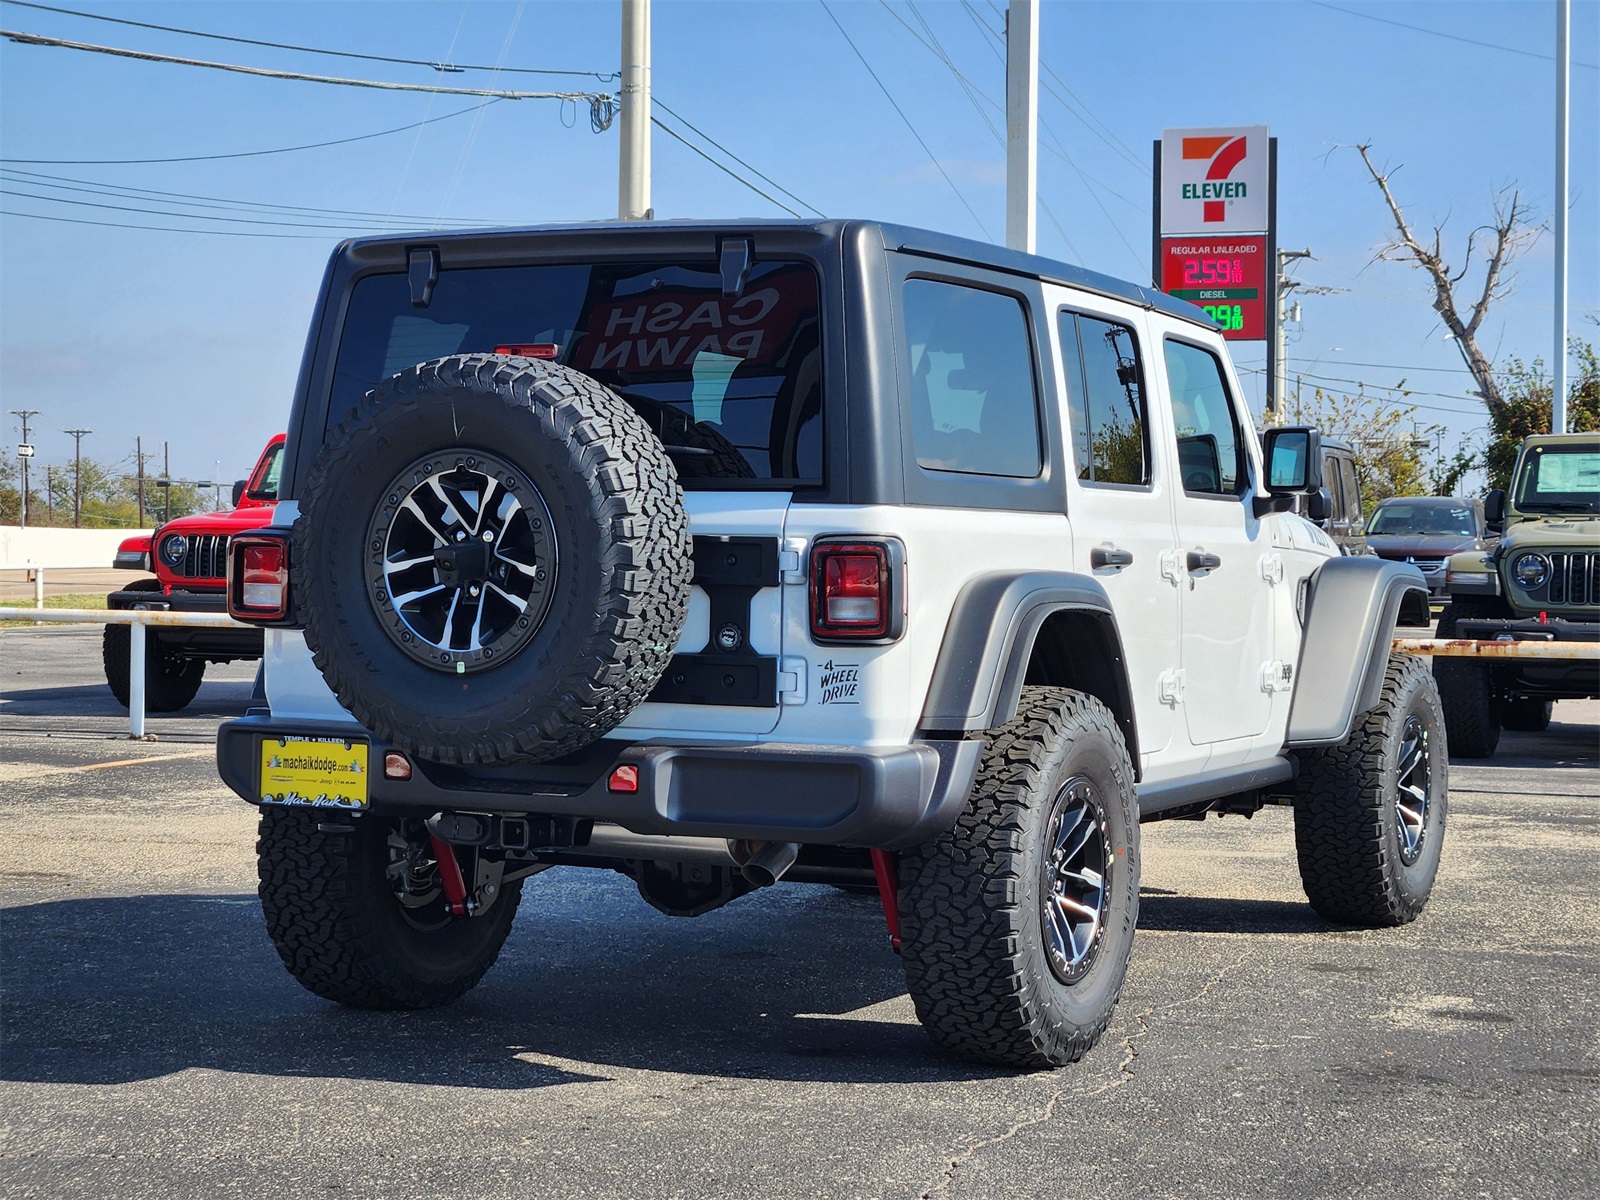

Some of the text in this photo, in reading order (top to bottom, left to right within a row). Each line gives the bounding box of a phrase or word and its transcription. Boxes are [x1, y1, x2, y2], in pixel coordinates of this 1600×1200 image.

[1182, 136, 1247, 222] 7
[1171, 245, 1257, 255] REGULAR UNLEADED
[1200, 290, 1227, 299] DIESEL
[824, 660, 834, 672] 4
[821, 670, 858, 689] WHEEL
[822, 684, 858, 705] DRIVE
[283, 755, 349, 774] machaikdodge.com
[282, 792, 342, 807] Mac Haik
